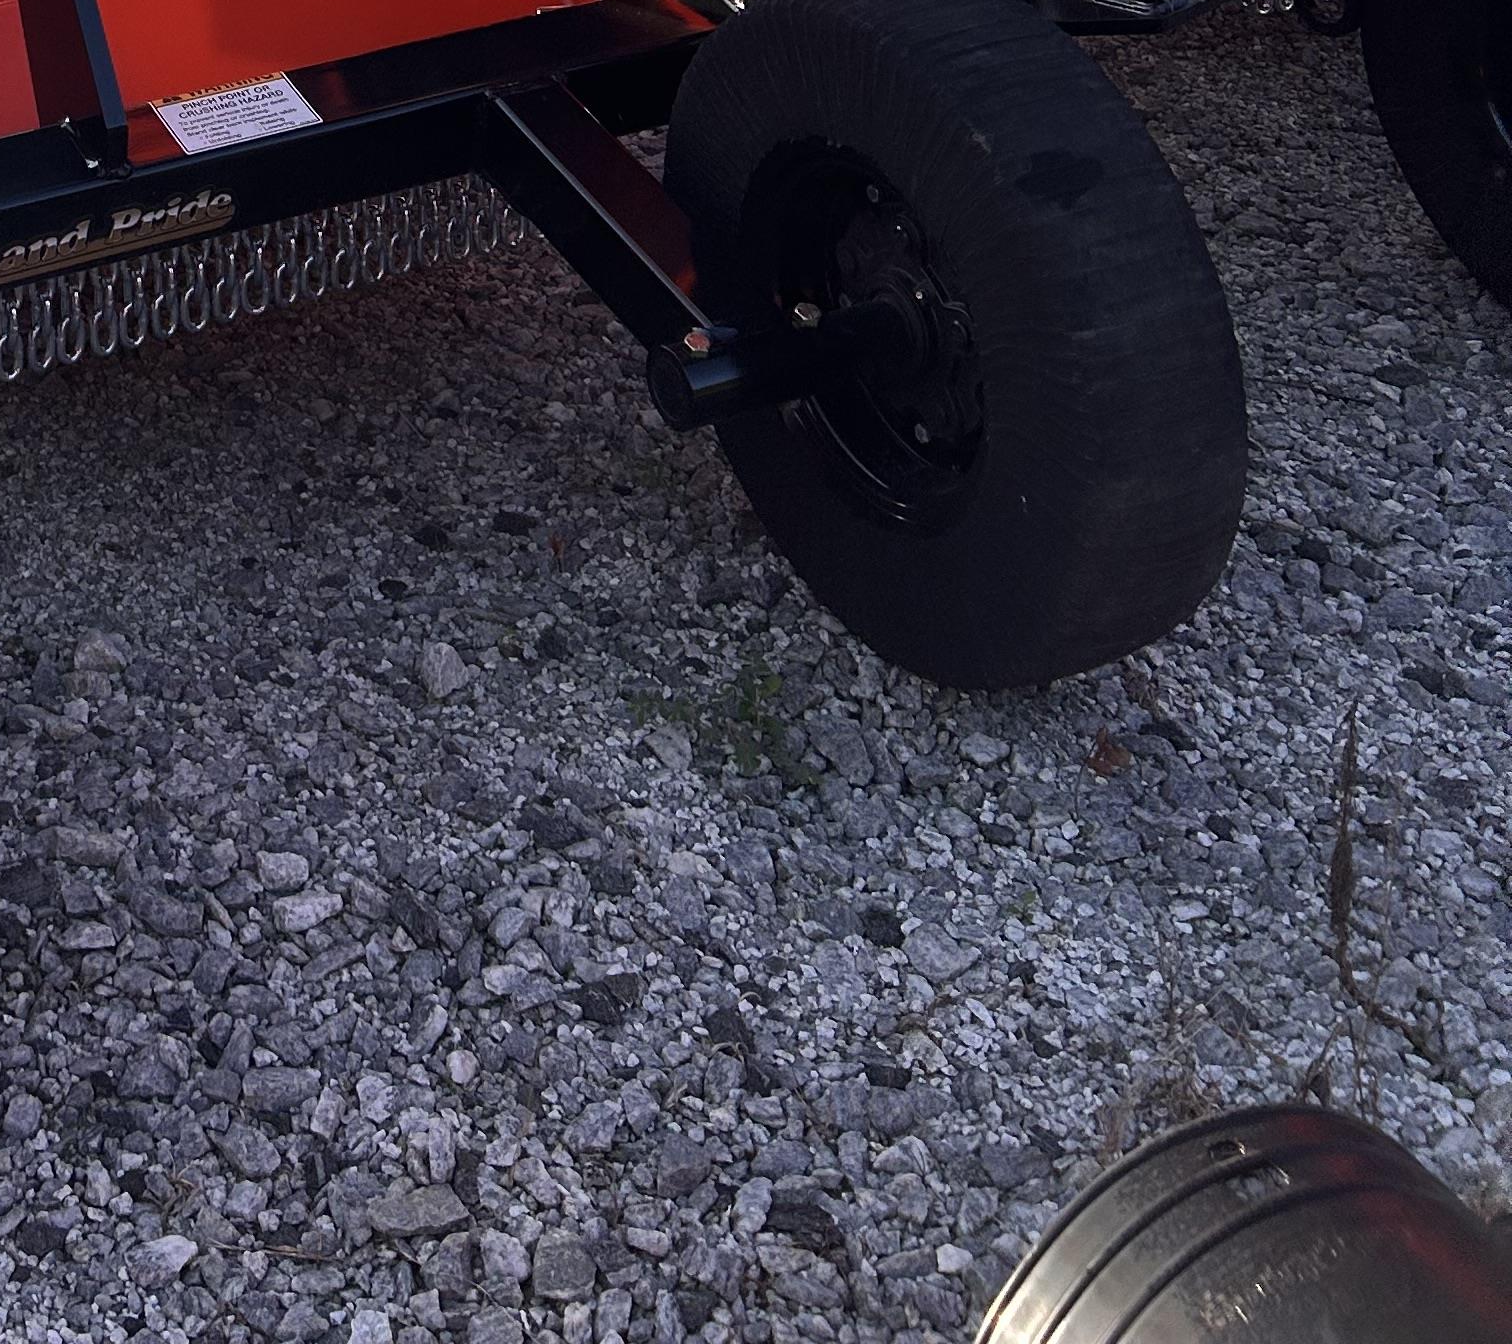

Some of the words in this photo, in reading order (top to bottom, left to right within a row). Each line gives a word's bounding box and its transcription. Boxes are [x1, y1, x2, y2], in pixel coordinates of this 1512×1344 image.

[178, 100, 238, 119] CRUSHING
[238, 89, 284, 105] HAZARD
[181, 97, 217, 111] PINCH
[218, 90, 251, 102] POINT
[253, 84, 270, 94] OR
[106, 189, 235, 242] Pride
